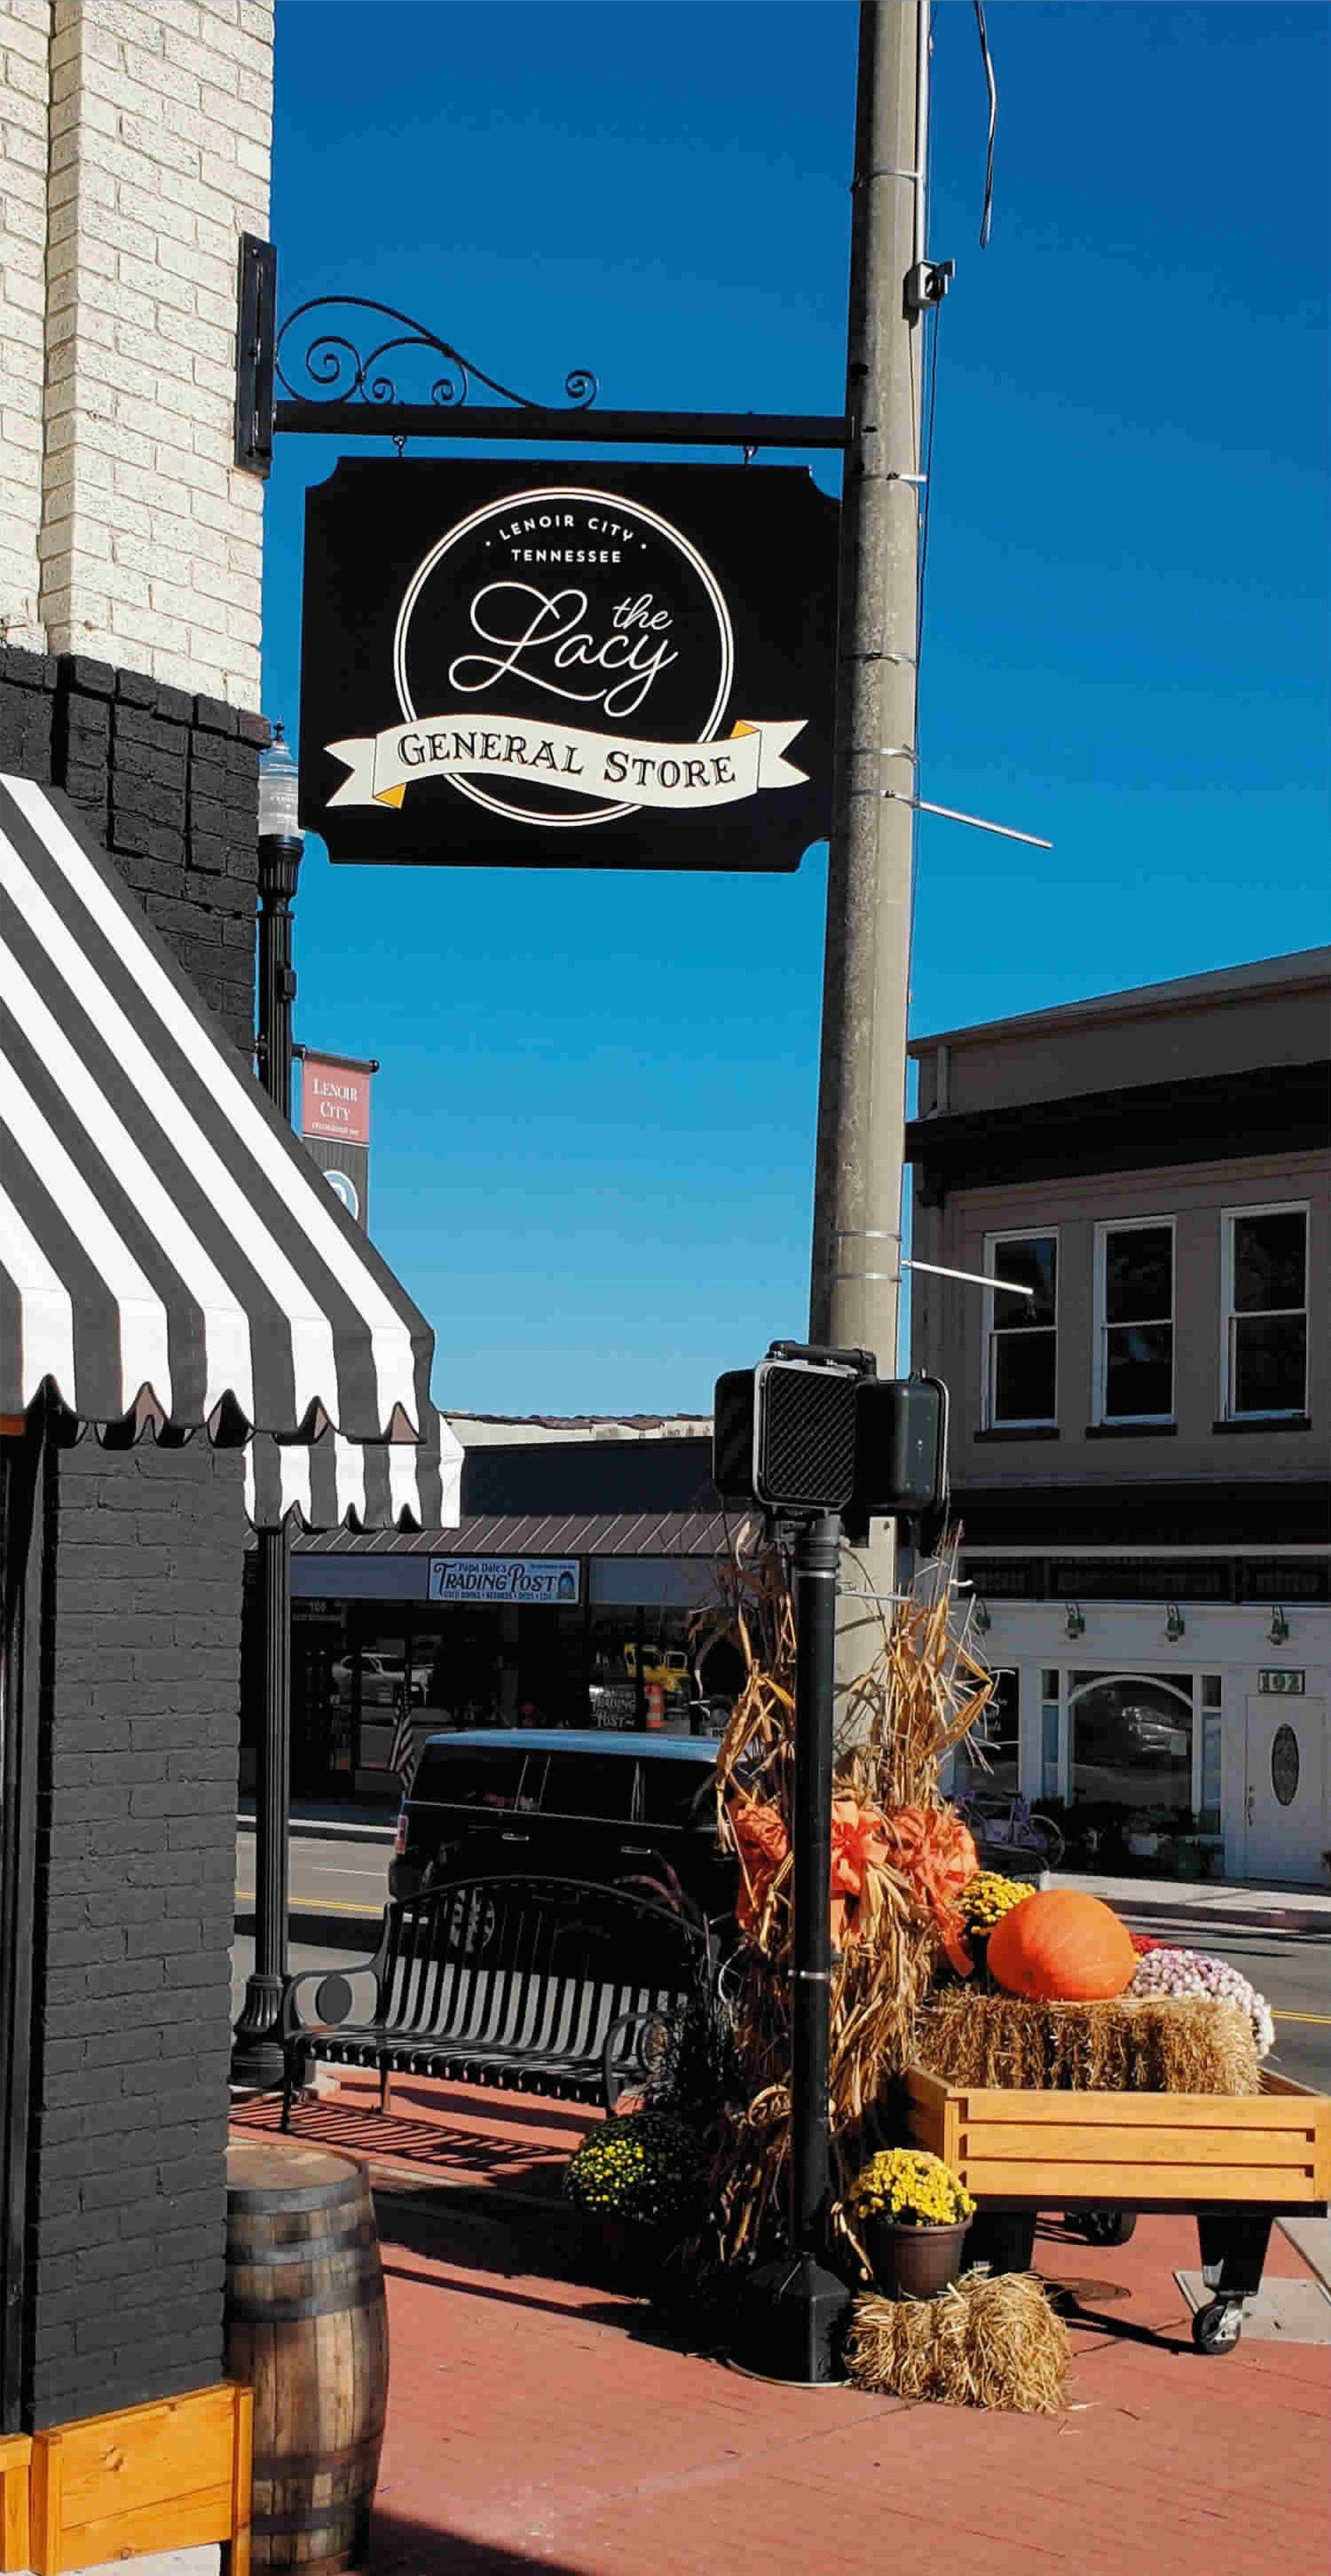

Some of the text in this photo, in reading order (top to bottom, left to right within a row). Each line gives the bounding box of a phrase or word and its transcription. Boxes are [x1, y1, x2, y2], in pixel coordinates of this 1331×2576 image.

[499, 514, 634, 543] LENOIR CITY
[511, 549, 621, 563] TENNESSEE
[612, 593, 673, 631] the
[449, 581, 679, 717] Lacy
[397, 732, 736, 789] GENERAL STORE
[312, 1077, 357, 1103] LENOIR
[320, 1101, 350, 1121] CITY
[434, 1562, 557, 1595] TRADING POST
